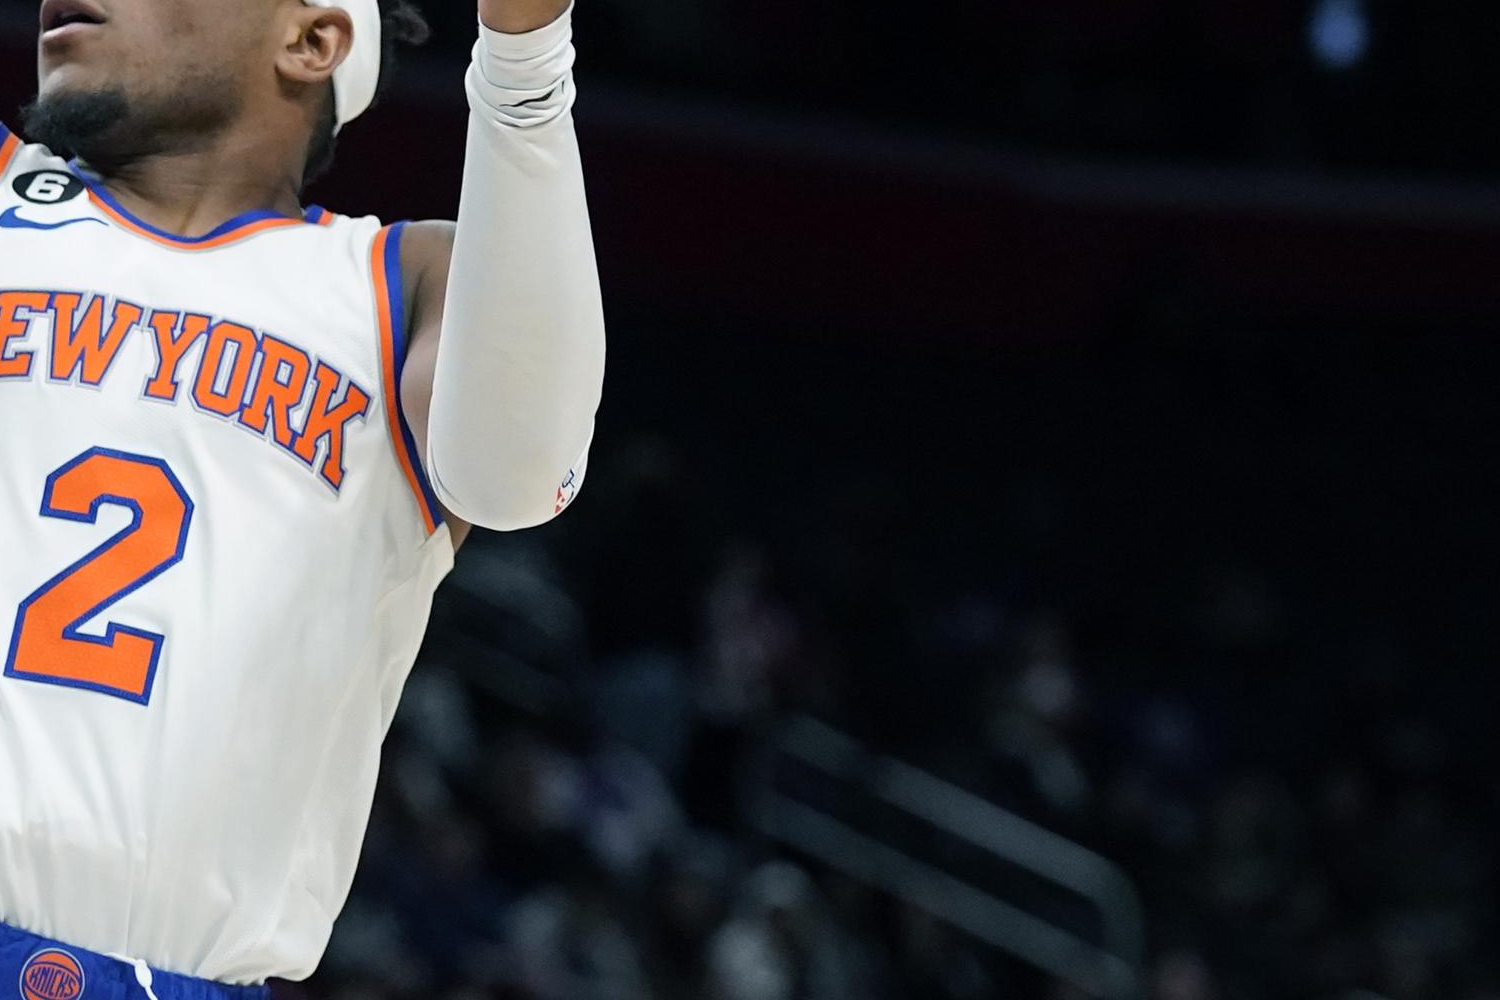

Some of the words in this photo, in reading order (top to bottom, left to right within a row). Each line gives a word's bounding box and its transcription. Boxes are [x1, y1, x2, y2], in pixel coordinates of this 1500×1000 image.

[25, 172, 70, 202] 6
[144, 308, 371, 492] YORK
[3, 445, 194, 706] 2
[29, 966, 77, 998] KNICKS
